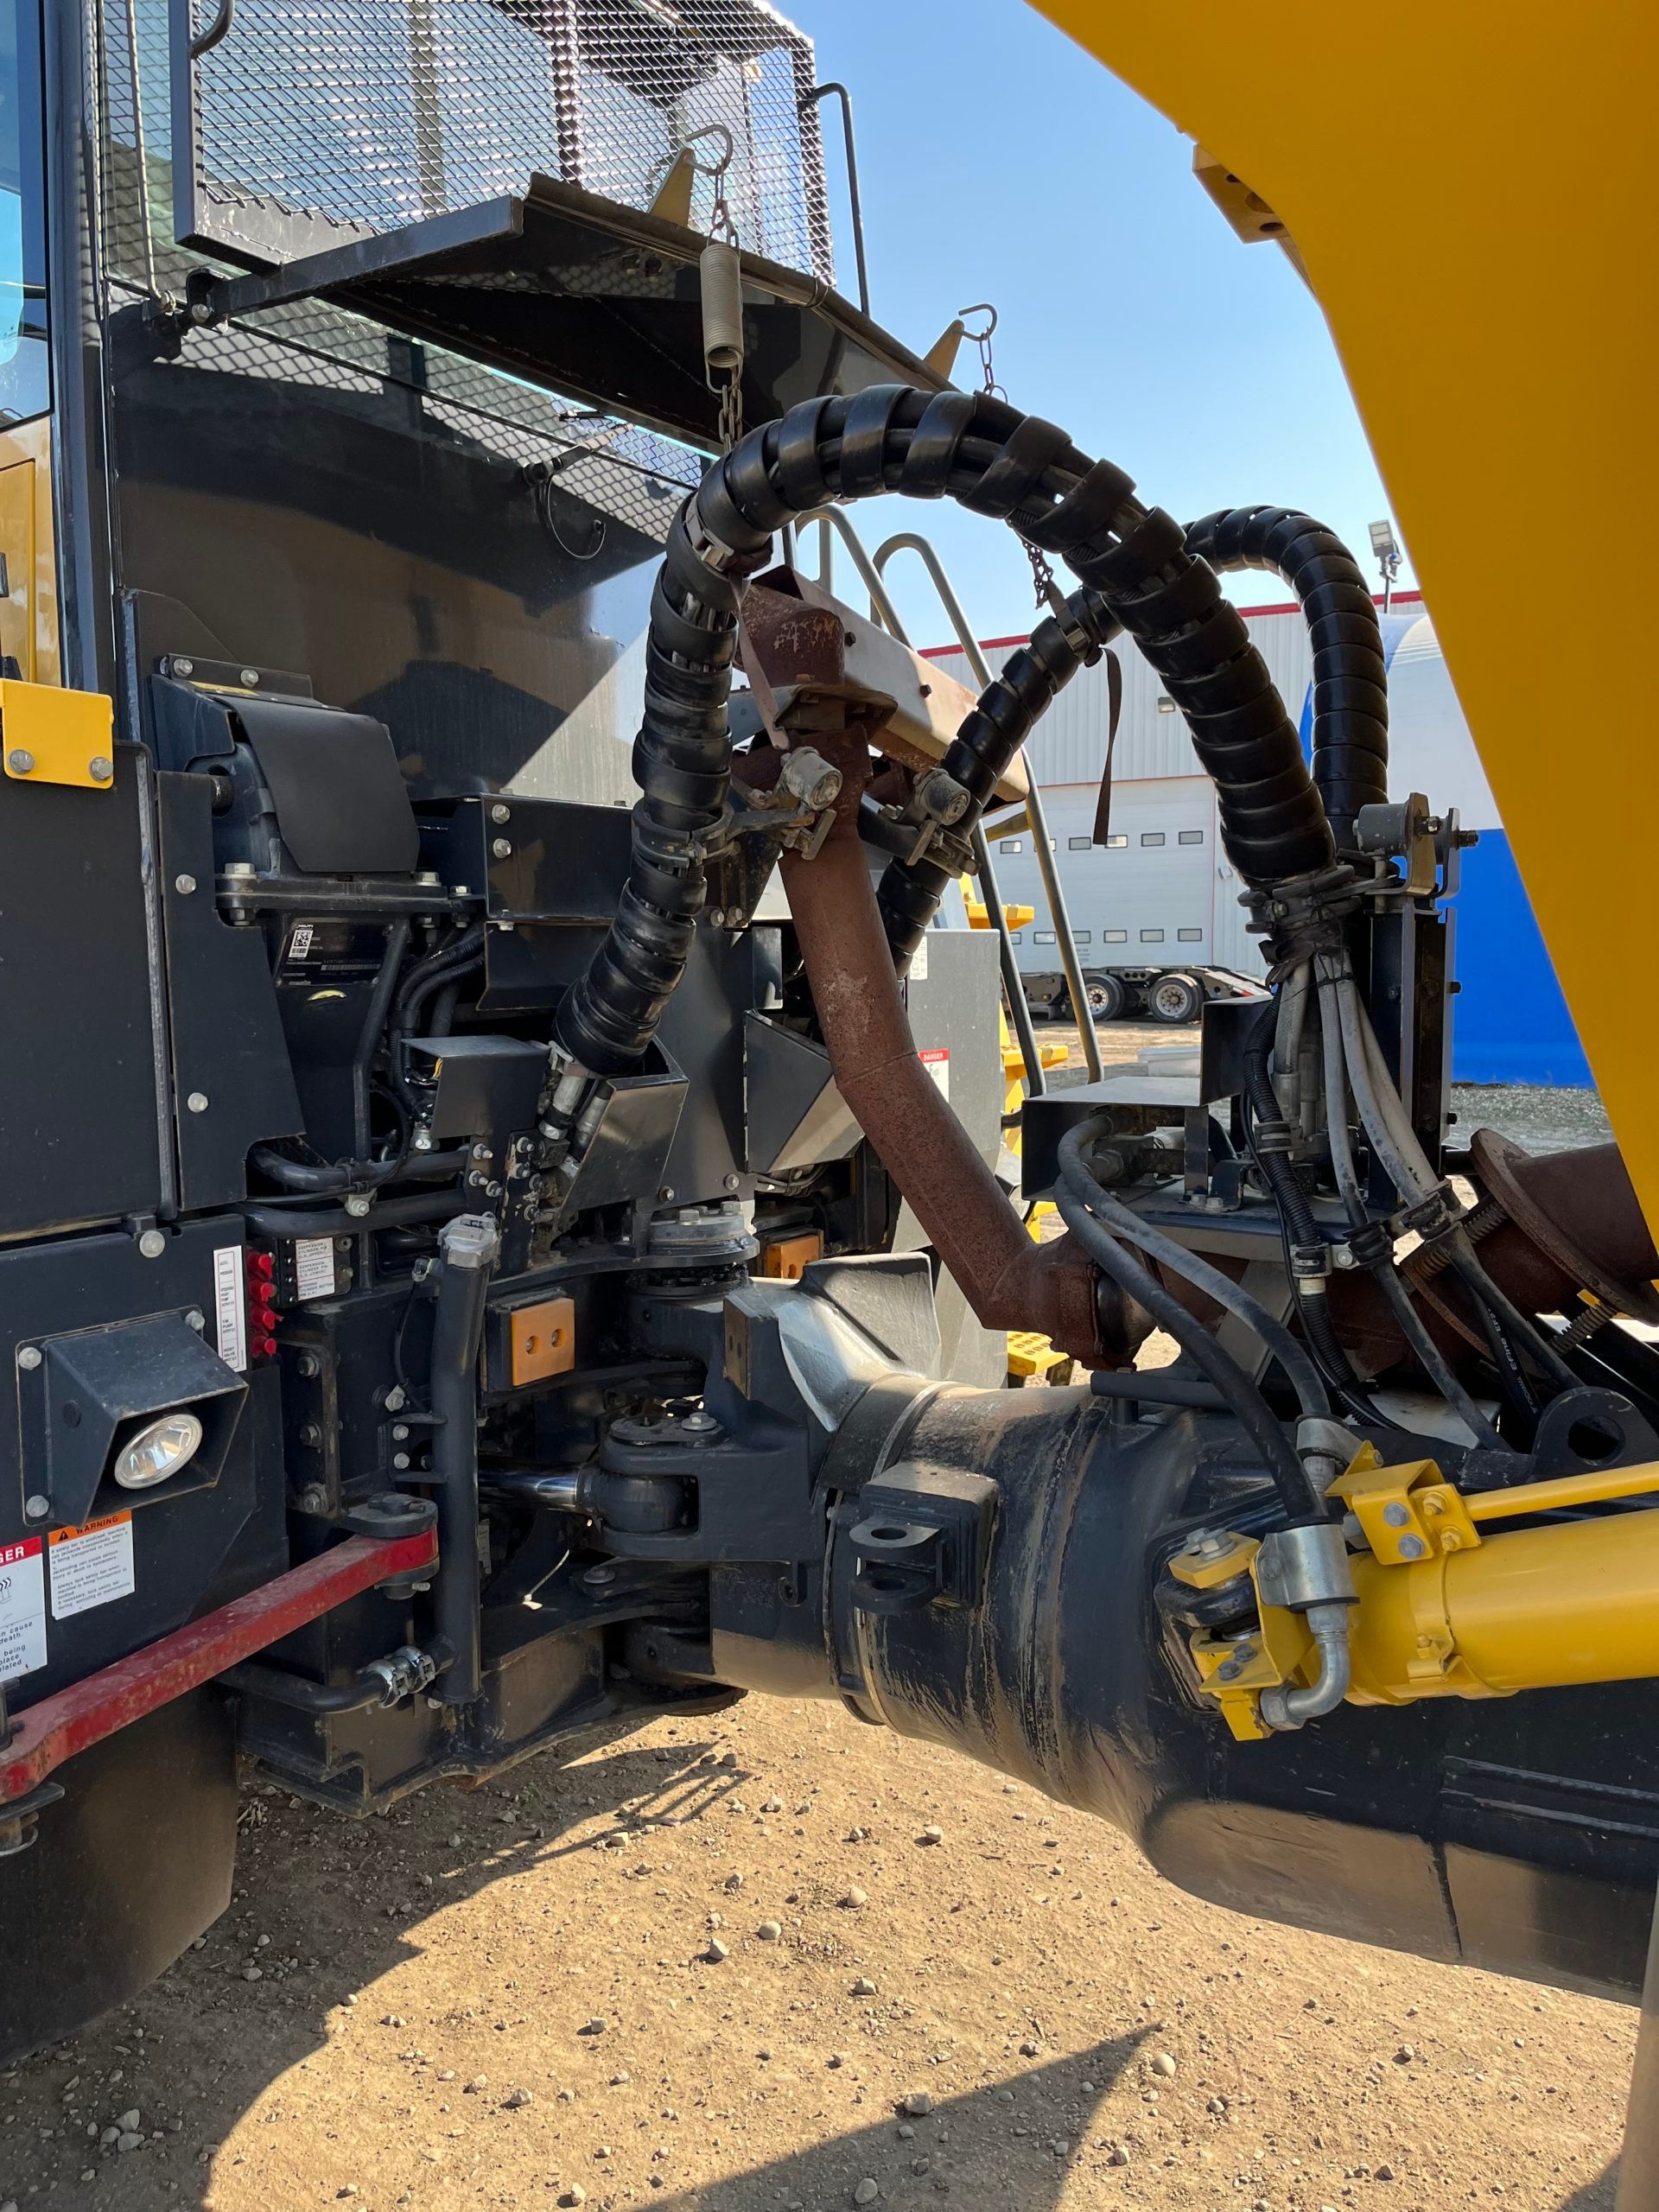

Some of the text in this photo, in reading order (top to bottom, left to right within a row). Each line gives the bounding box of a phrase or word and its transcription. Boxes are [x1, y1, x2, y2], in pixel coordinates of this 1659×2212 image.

[923, 1052, 944, 1061] DANGER
[76, 1516, 118, 1535] WARNING
[10, 1621, 33, 1634] cause
[3, 1644, 26, 1656] being
[0, 1658, 22, 1672] lated
